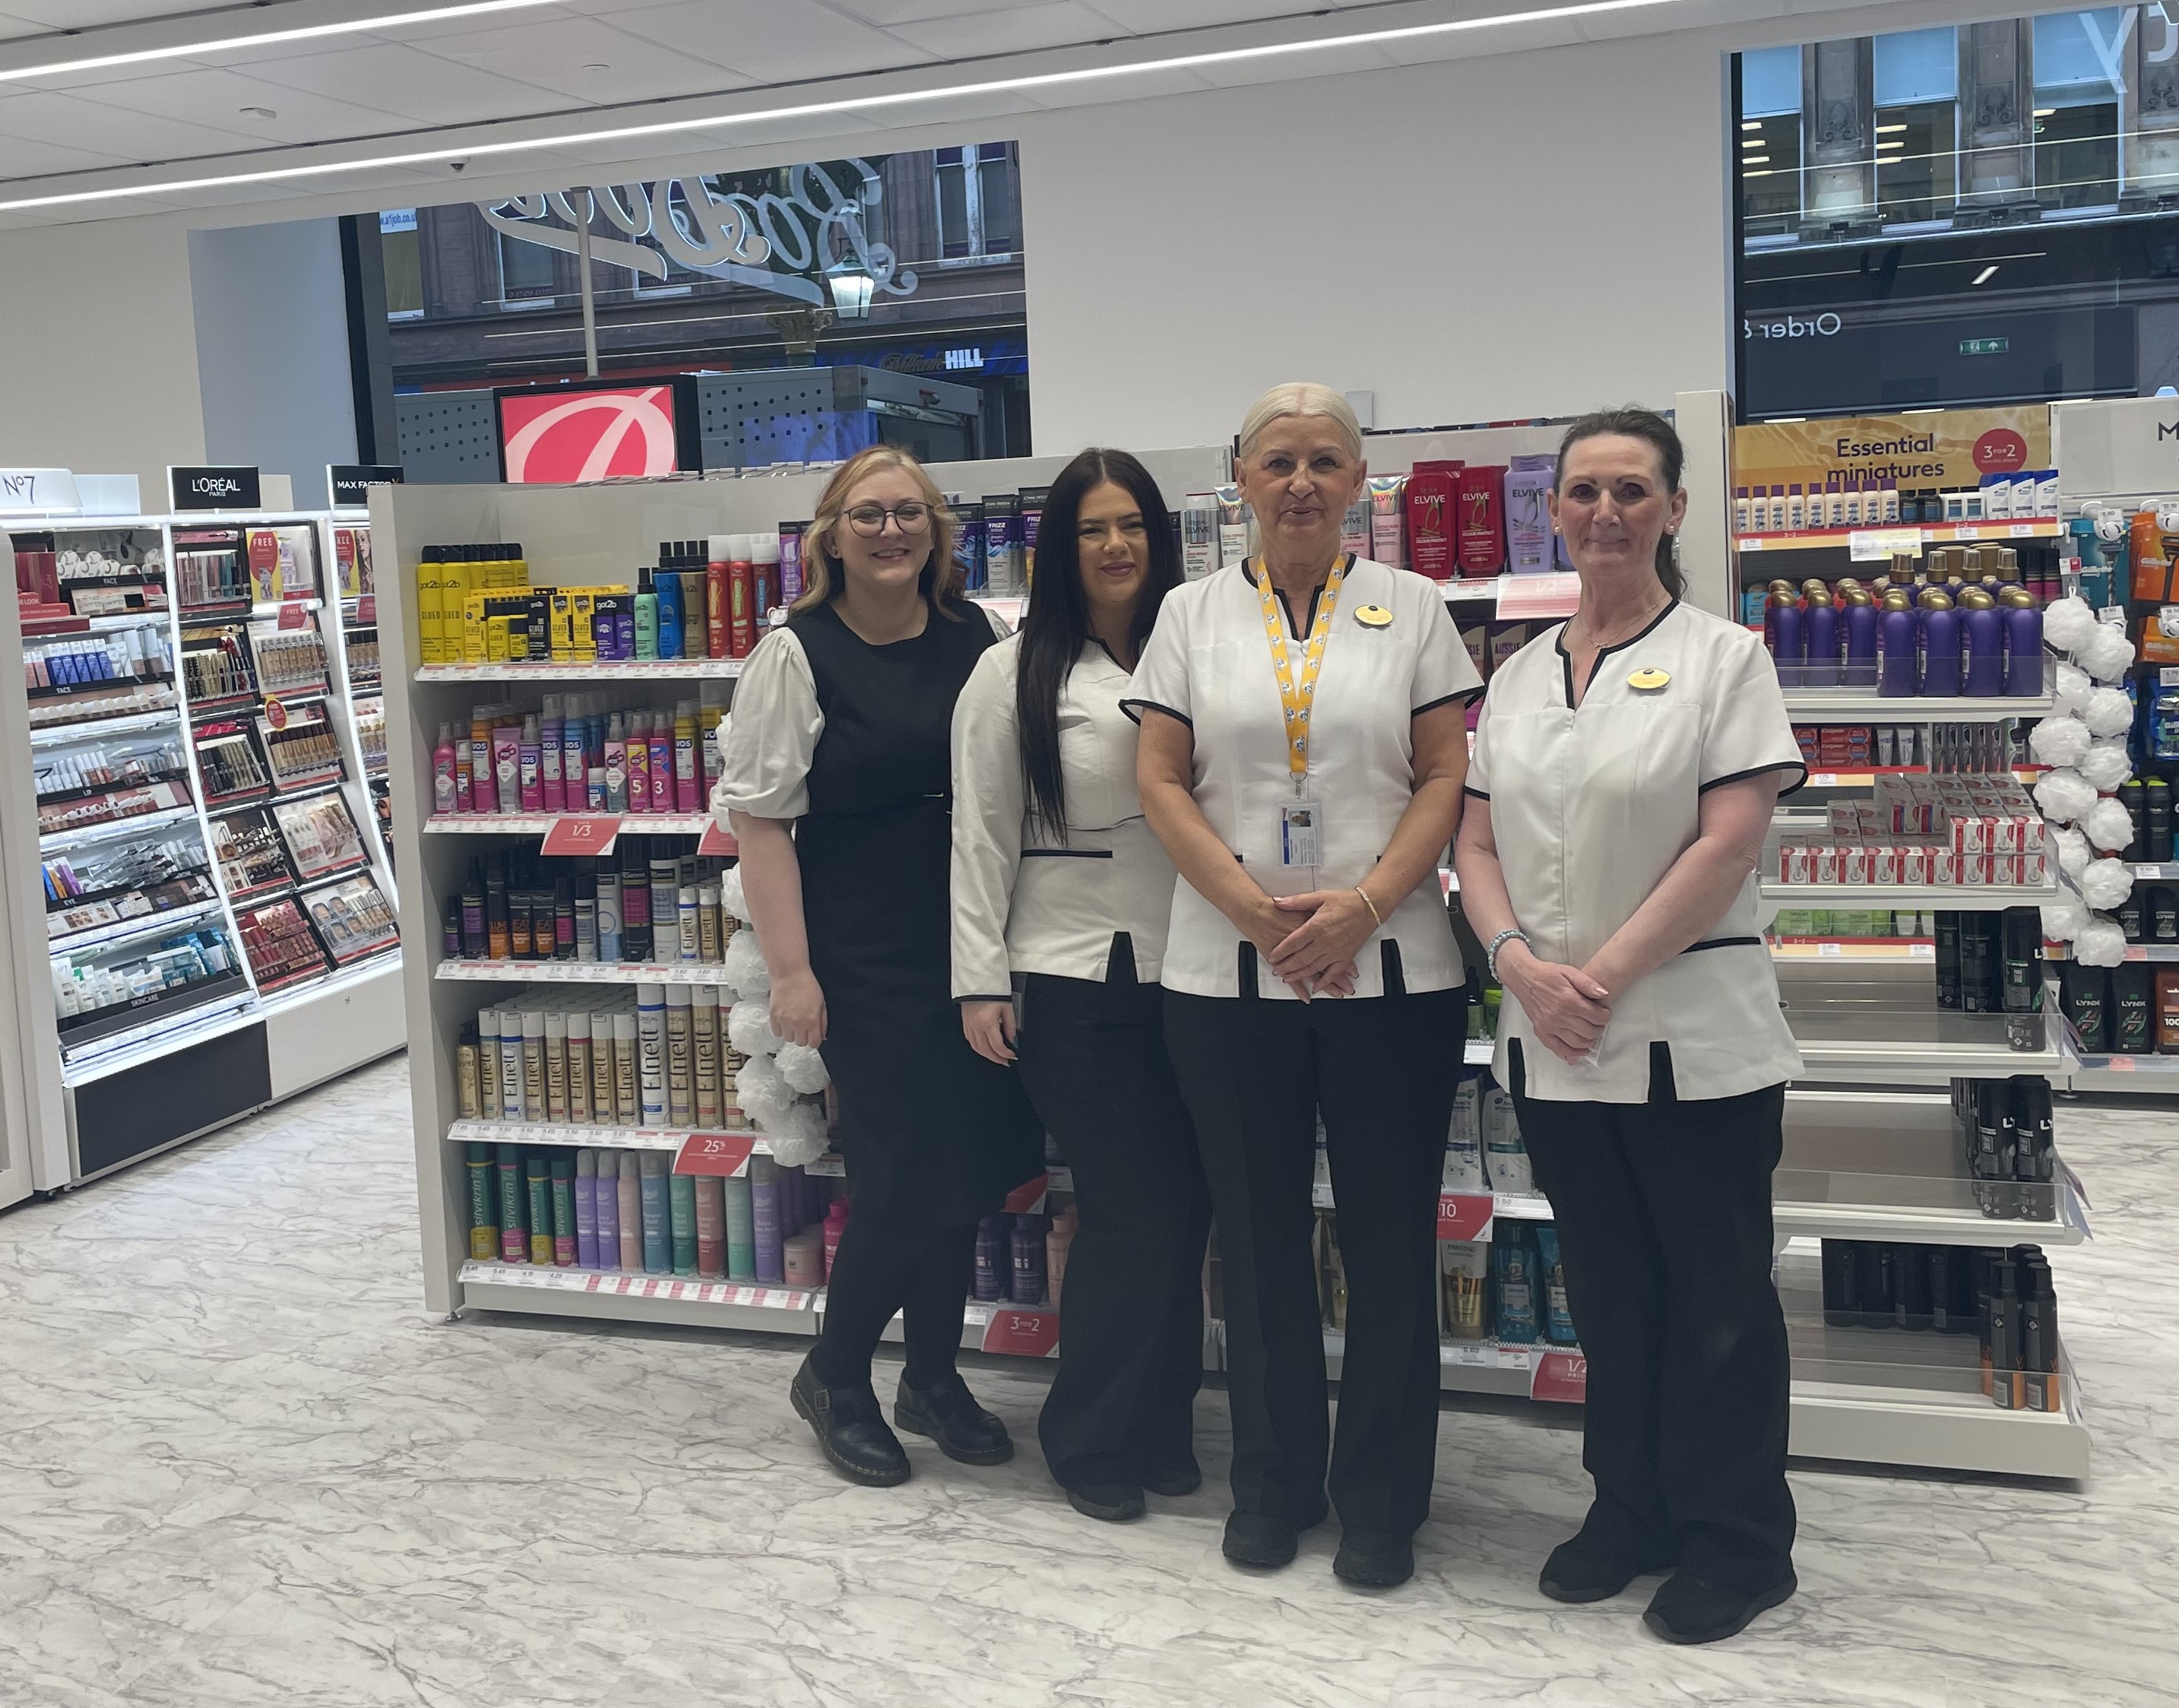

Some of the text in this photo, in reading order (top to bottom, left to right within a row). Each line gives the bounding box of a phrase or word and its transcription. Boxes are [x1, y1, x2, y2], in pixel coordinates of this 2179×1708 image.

[945, 348, 984, 370] HILL
[1837, 433, 1934, 458] Essential
[1827, 461, 1945, 483] miniatures
[192, 477, 241, 493] L'ORÉAL
[337, 480, 356, 490] MAX
[1512, 487, 1544, 498] ELVIVE
[1372, 494, 1398, 502] ELVIVE
[1414, 495, 1446, 505] ELVIVE
[1462, 493, 1490, 501] ELVIVE
[1219, 504, 1245, 512] ELVIVE
[1341, 517, 1363, 525] VIVE
[1186, 526, 1211, 534] ELVIVE
[252, 537, 273, 547] FREE
[337, 535, 350, 545] REE
[103, 577, 118, 585] FACE
[596, 599, 617, 610] got2b
[421, 610, 441, 620] GLUED
[528, 624, 544, 633] GLUED
[565, 741, 580, 749] VO5
[632, 779, 643, 794] 5
[654, 781, 664, 794] 3
[572, 825, 592, 837] 1/3
[681, 916, 694, 949] Elnett
[703, 917, 714, 950] Elnett
[131, 993, 160, 1008] SKINCARE
[641, 1028, 661, 1090] Elnett
[668, 1030, 688, 1091] Elnett
[695, 1030, 715, 1092] Elnett
[482, 1052, 493, 1095] Elnett
[504, 1053, 517, 1096] Elnett
[525, 1054, 540, 1097] Elnett
[549, 1055, 562, 1098] Elnett
[571, 1056, 583, 1098] Elnett
[594, 1057, 608, 1099] Elnett
[619, 1057, 634, 1100] Elnett
[473, 1179, 483, 1226] silvikrin
[505, 1182, 517, 1228] silvikrin
[530, 1191, 540, 1234] silvikrin
[556, 1193, 565, 1236] silvikrin
